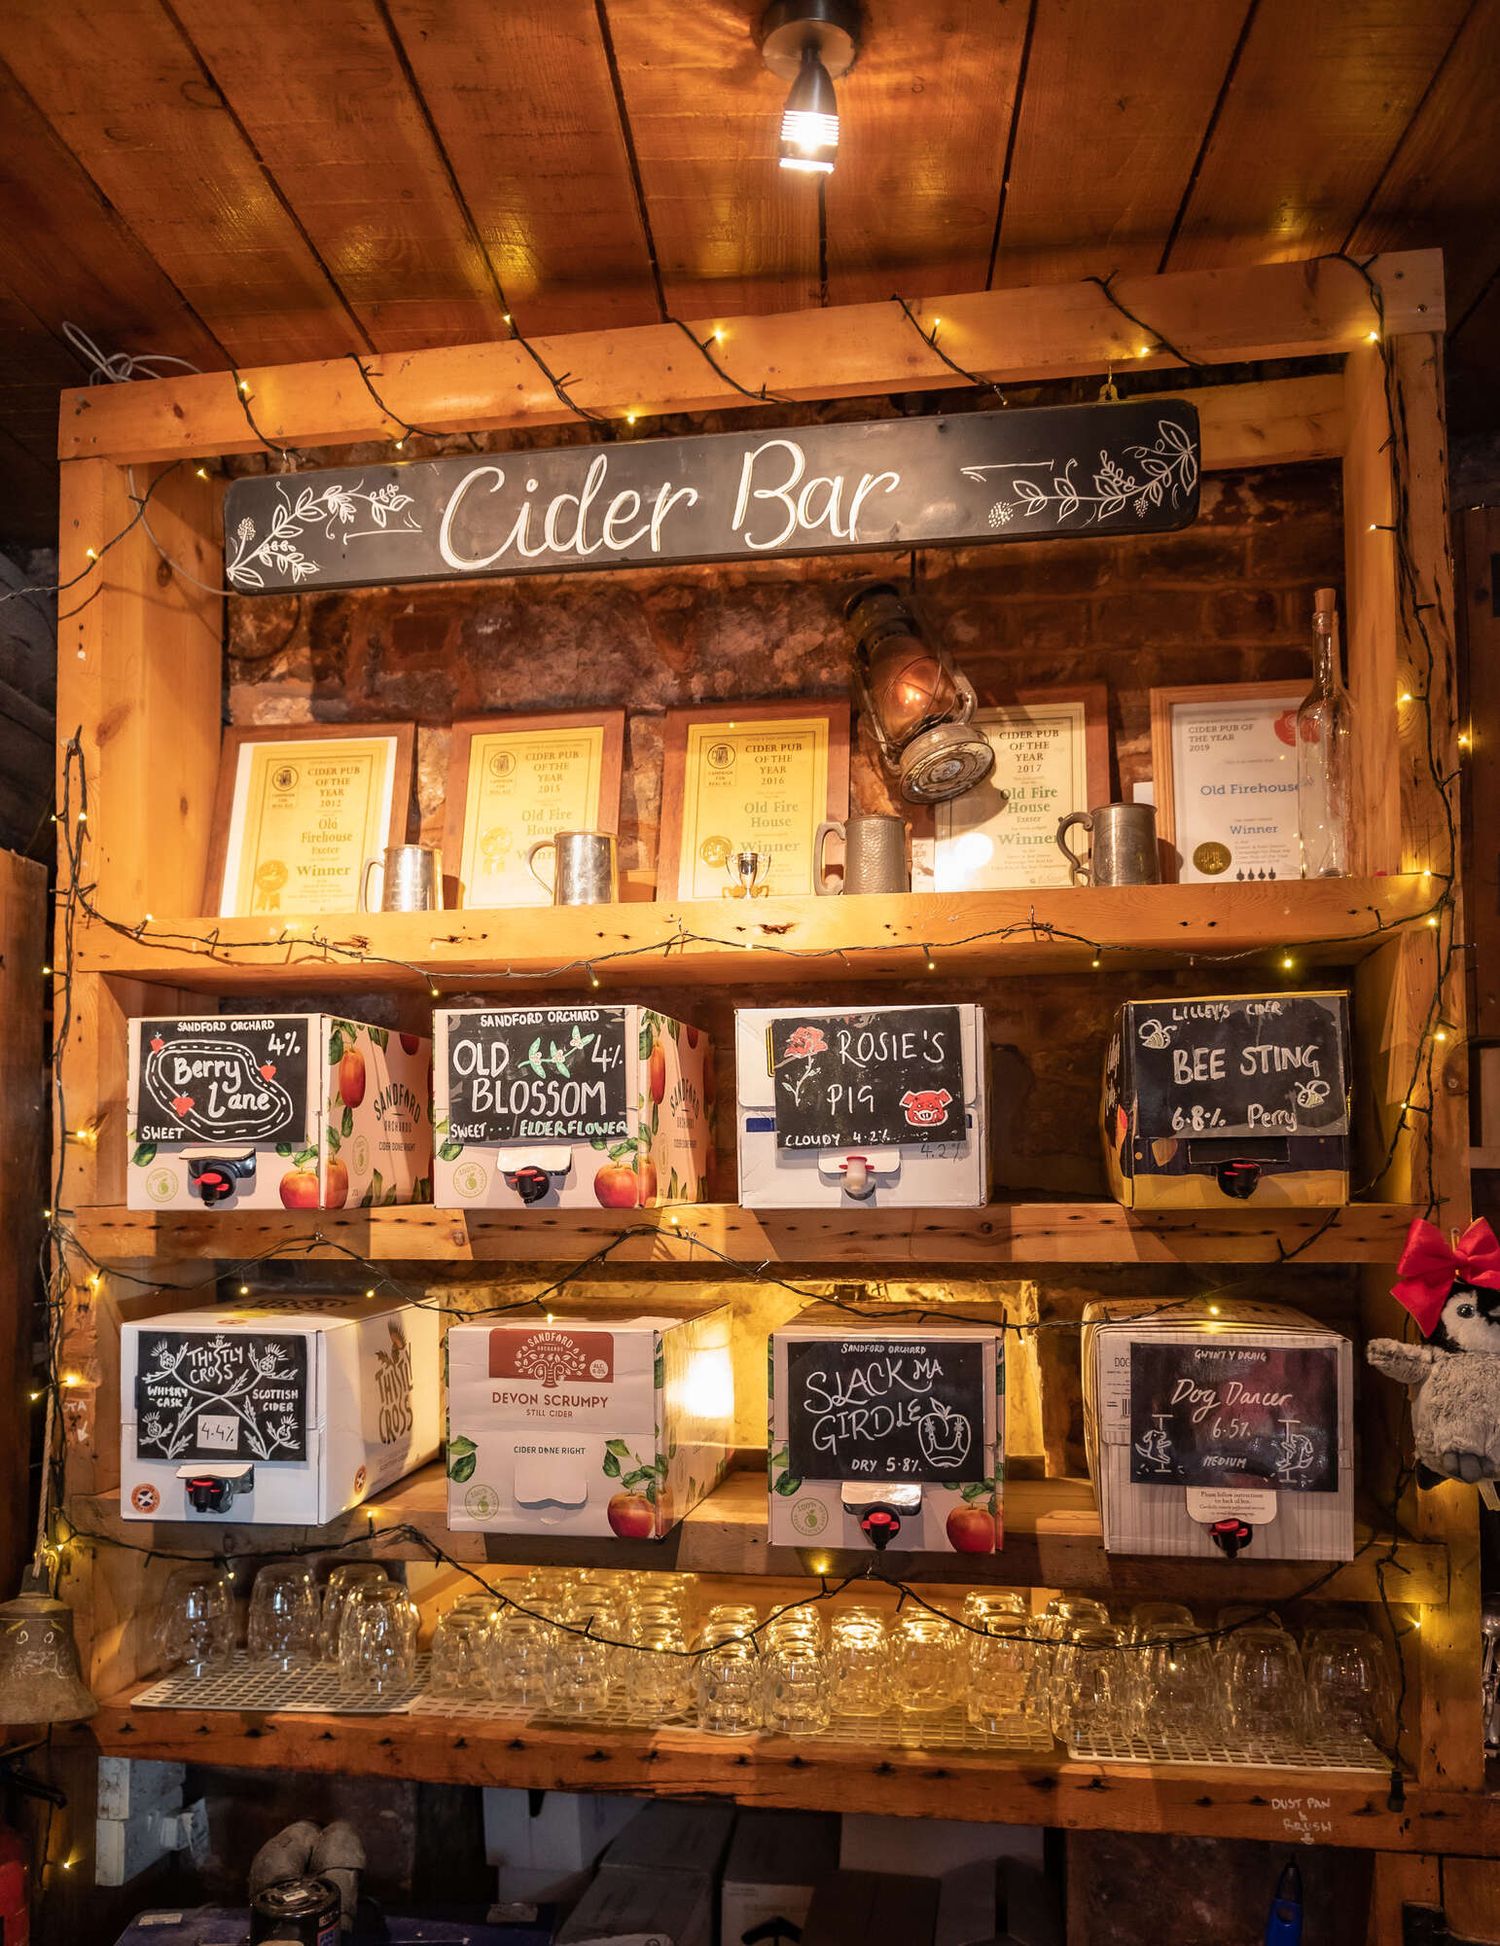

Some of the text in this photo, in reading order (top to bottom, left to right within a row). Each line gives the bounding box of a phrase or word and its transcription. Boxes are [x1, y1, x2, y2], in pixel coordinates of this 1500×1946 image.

[440, 439, 900, 570] Cider Bar
[999, 730, 1059, 740] CIDER PUB
[1188, 724, 1218, 733] CIDER
[1220, 724, 1239, 732] PUB
[1210, 733, 1235, 742] YEAR
[746, 743, 802, 753] CIDER PUB
[1010, 742, 1050, 751] OF THE
[1189, 744, 1210, 752] 2019
[525, 751, 580, 760] CIDER PUB
[754, 754, 792, 764] OF THE
[1016, 753, 1044, 762] YEAR
[308, 766, 360, 777] CIDER PUB
[534, 762, 569, 771] OF THE
[760, 766, 787, 775] YEAR
[1017, 764, 1042, 773] 2017
[316, 778, 350, 787] OF THE
[538, 774, 564, 782] YEAR
[761, 777, 784, 786] 2016
[320, 788, 344, 797] YEAR
[1001, 786, 1058, 800] Old Fire
[1200, 784, 1226, 796] Old
[744, 800, 798, 814] Old Fire
[1008, 802, 1050, 814] House
[521, 809, 572, 822] Old Fire
[751, 816, 792, 828] House
[318, 818, 338, 831] Old
[1230, 825, 1278, 835] Winner
[300, 830, 353, 844] Firehouse
[741, 841, 800, 852] Winner
[296, 864, 352, 877] Winner
[480, 1010, 600, 1028] SANDFORD ORCHARD
[177, 1020, 276, 1032] SANDFORD ORCHARD
[268, 1031, 301, 1056] 4%
[836, 1030, 945, 1068] ROSIE'S
[452, 1039, 510, 1078] OLD
[1173, 1044, 1320, 1085] BEE STING
[174, 1056, 242, 1094] Berry
[207, 1082, 271, 1118] Lane
[374, 1082, 421, 1124] SANDFORD
[471, 1078, 607, 1117] BLOSSOM
[826, 1084, 874, 1116] PIG
[1247, 1102, 1298, 1132] Perry
[142, 1126, 184, 1141] SWEET
[450, 1120, 628, 1138] SWEET ELDERFLOWER
[785, 1132, 841, 1146] CLOUDY
[528, 1332, 574, 1349] SANDFORD
[840, 1342, 927, 1355] SANDFORD ORCHARD
[186, 1346, 244, 1368] THISTLY
[190, 1363, 234, 1384] CROSS
[375, 1343, 414, 1405] THISTLY
[803, 1358, 944, 1414] SLACK MA
[252, 1388, 299, 1400] SCOTTISH
[492, 1391, 609, 1409] DEVON SCRUMPY
[1170, 1378, 1222, 1423] Dog
[1226, 1382, 1294, 1408] Dancer
[262, 1402, 295, 1412] CIDER
[526, 1408, 574, 1418] STILL CIDER
[378, 1394, 414, 1445] CROSS
[200, 1422, 234, 1442] 4.4%
[812, 1398, 922, 1456] GIRDLE
[513, 1446, 586, 1455] CIDER DONE RIGHT
[851, 1458, 878, 1472] DRY
[1203, 1455, 1248, 1468] MEDIUM
[1271, 1797, 1330, 1810] DUST PAN
[1282, 1818, 1332, 1832] BRUSH
